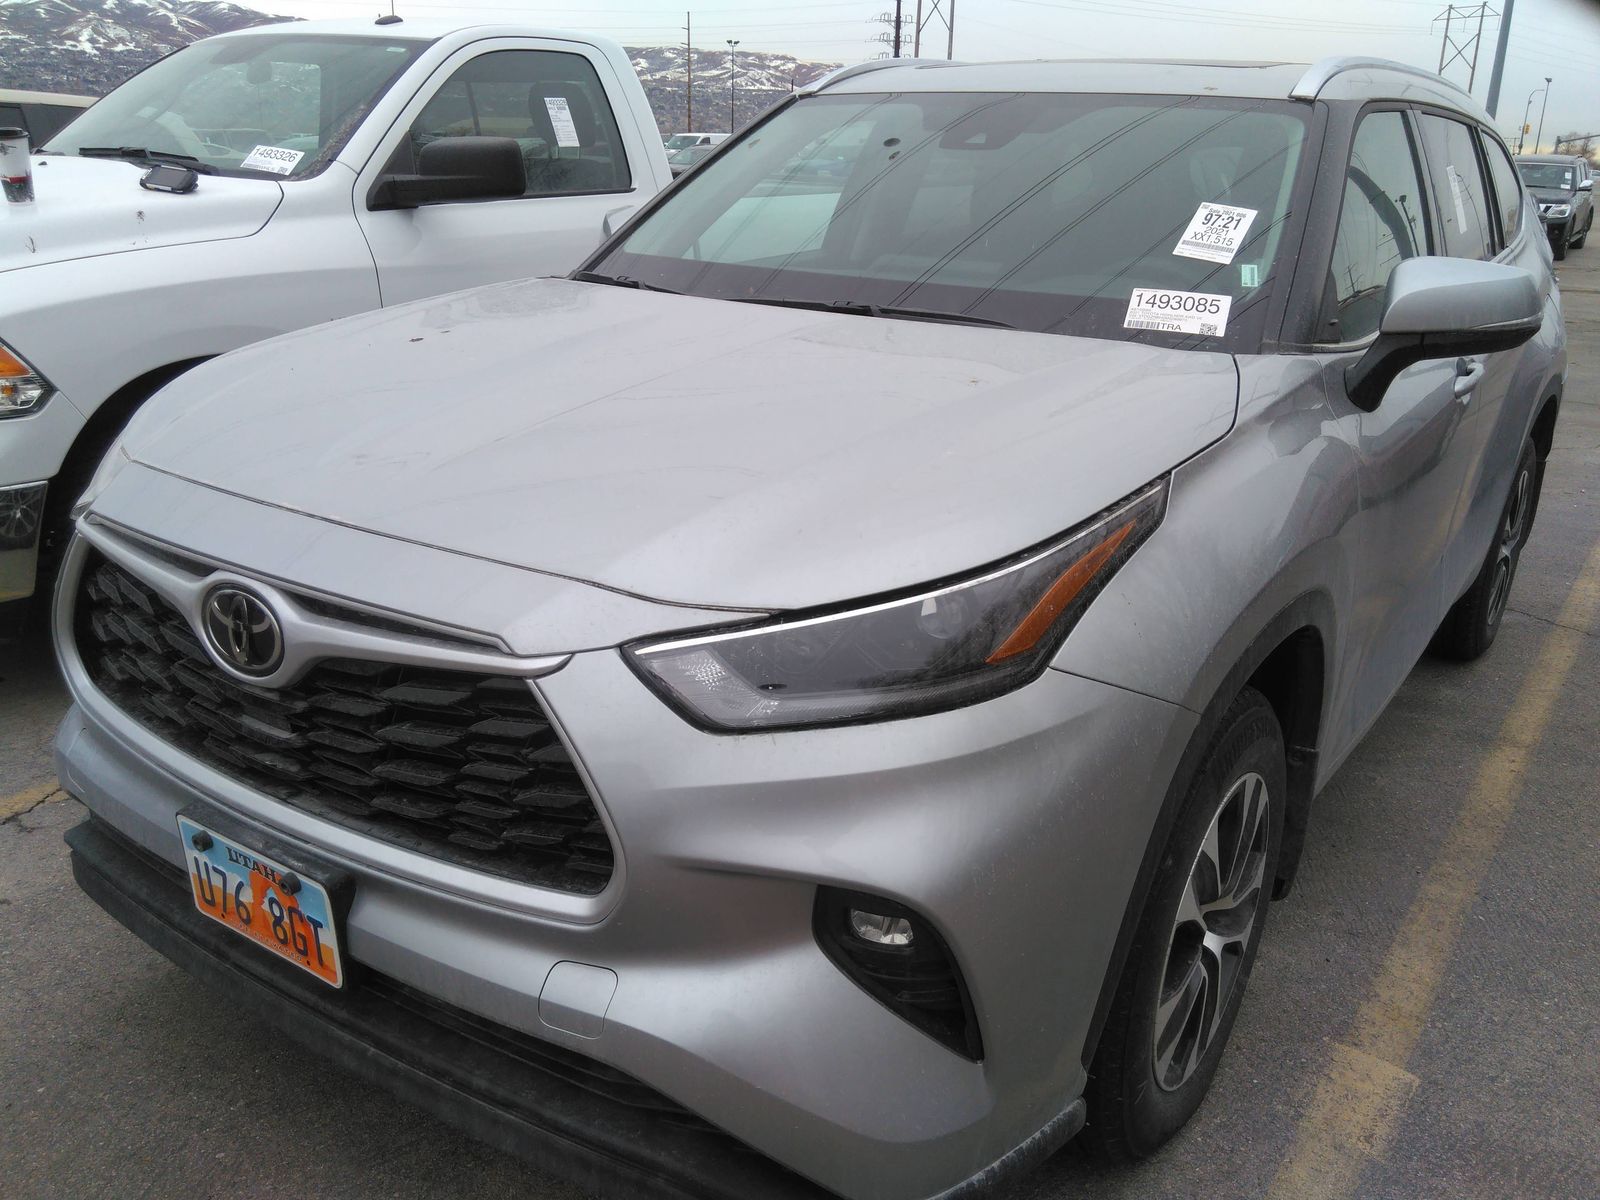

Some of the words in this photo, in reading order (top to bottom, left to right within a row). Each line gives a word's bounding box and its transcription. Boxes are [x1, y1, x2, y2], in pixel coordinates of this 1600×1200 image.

[253, 148, 298, 163] 1493326
[1202, 212, 1242, 231] 97:21
[1204, 226, 1230, 237] 2021
[1135, 292, 1221, 314] 1493085
[1161, 322, 1183, 331] TRA
[225, 846, 280, 884] UTAH
[193, 855, 252, 926] U76
[268, 896, 324, 968] 8GT
